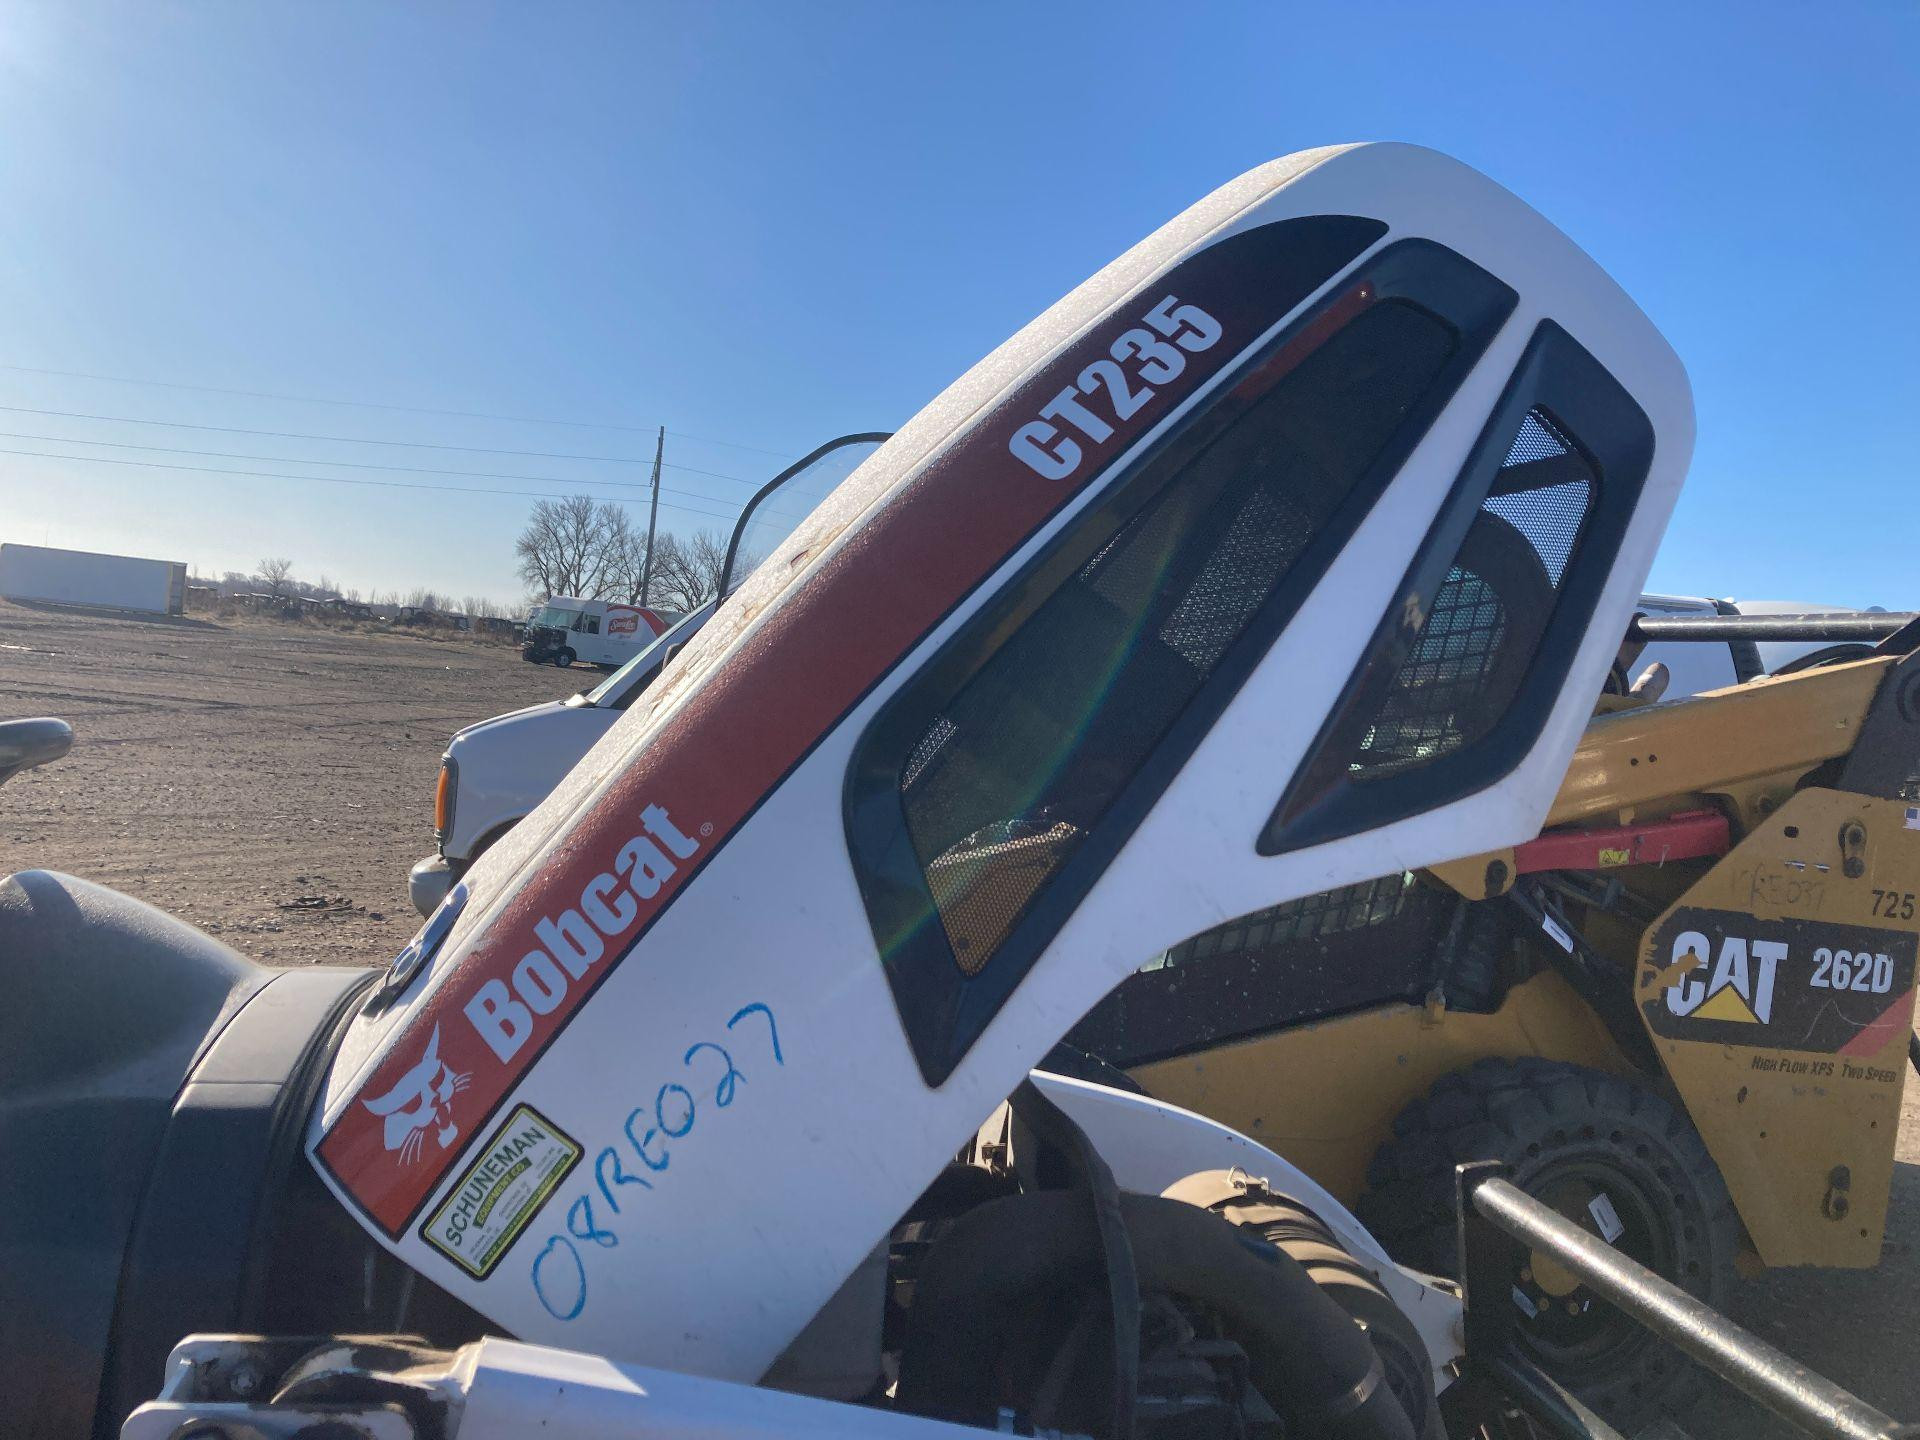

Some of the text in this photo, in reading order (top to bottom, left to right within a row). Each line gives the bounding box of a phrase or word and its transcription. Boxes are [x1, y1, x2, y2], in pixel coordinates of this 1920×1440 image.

[1009, 295, 1223, 480] CT235
[464, 803, 699, 1064] Bobcat
[1667, 931, 1894, 1025] CAT 262D
[1872, 889, 1916, 920] 725
[445, 1126, 547, 1247] SCHUNEMAN
[531, 1003, 784, 1320] 08RE027
